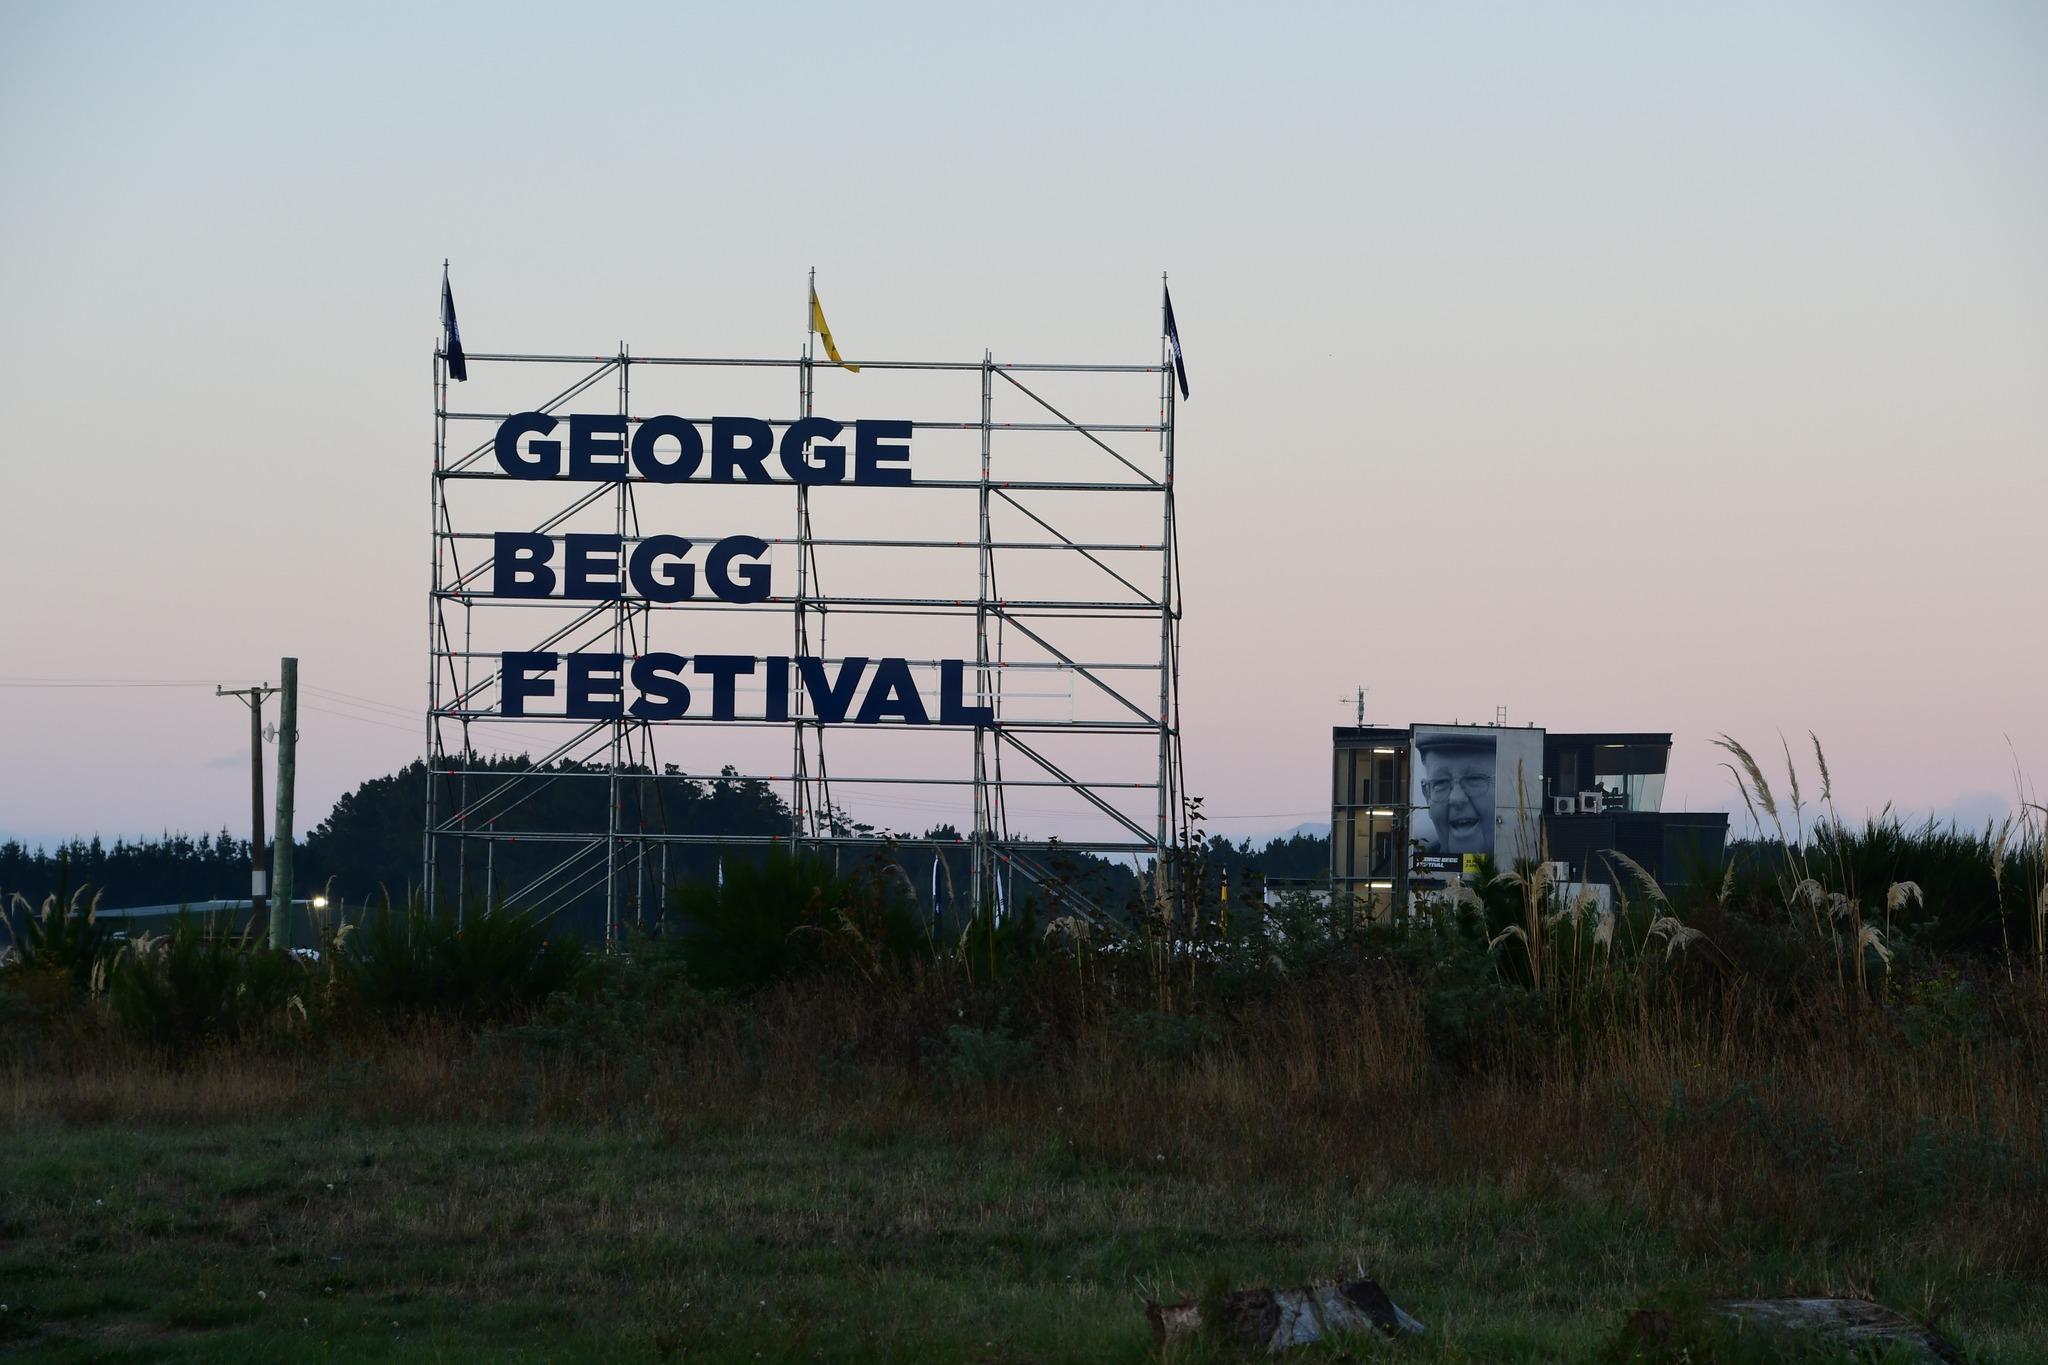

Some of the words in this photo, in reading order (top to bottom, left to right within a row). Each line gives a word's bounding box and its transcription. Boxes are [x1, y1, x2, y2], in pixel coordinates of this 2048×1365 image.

[494, 411, 913, 486] GEORGE
[494, 531, 772, 603] BEGG
[501, 651, 995, 728] FESTIVAL
